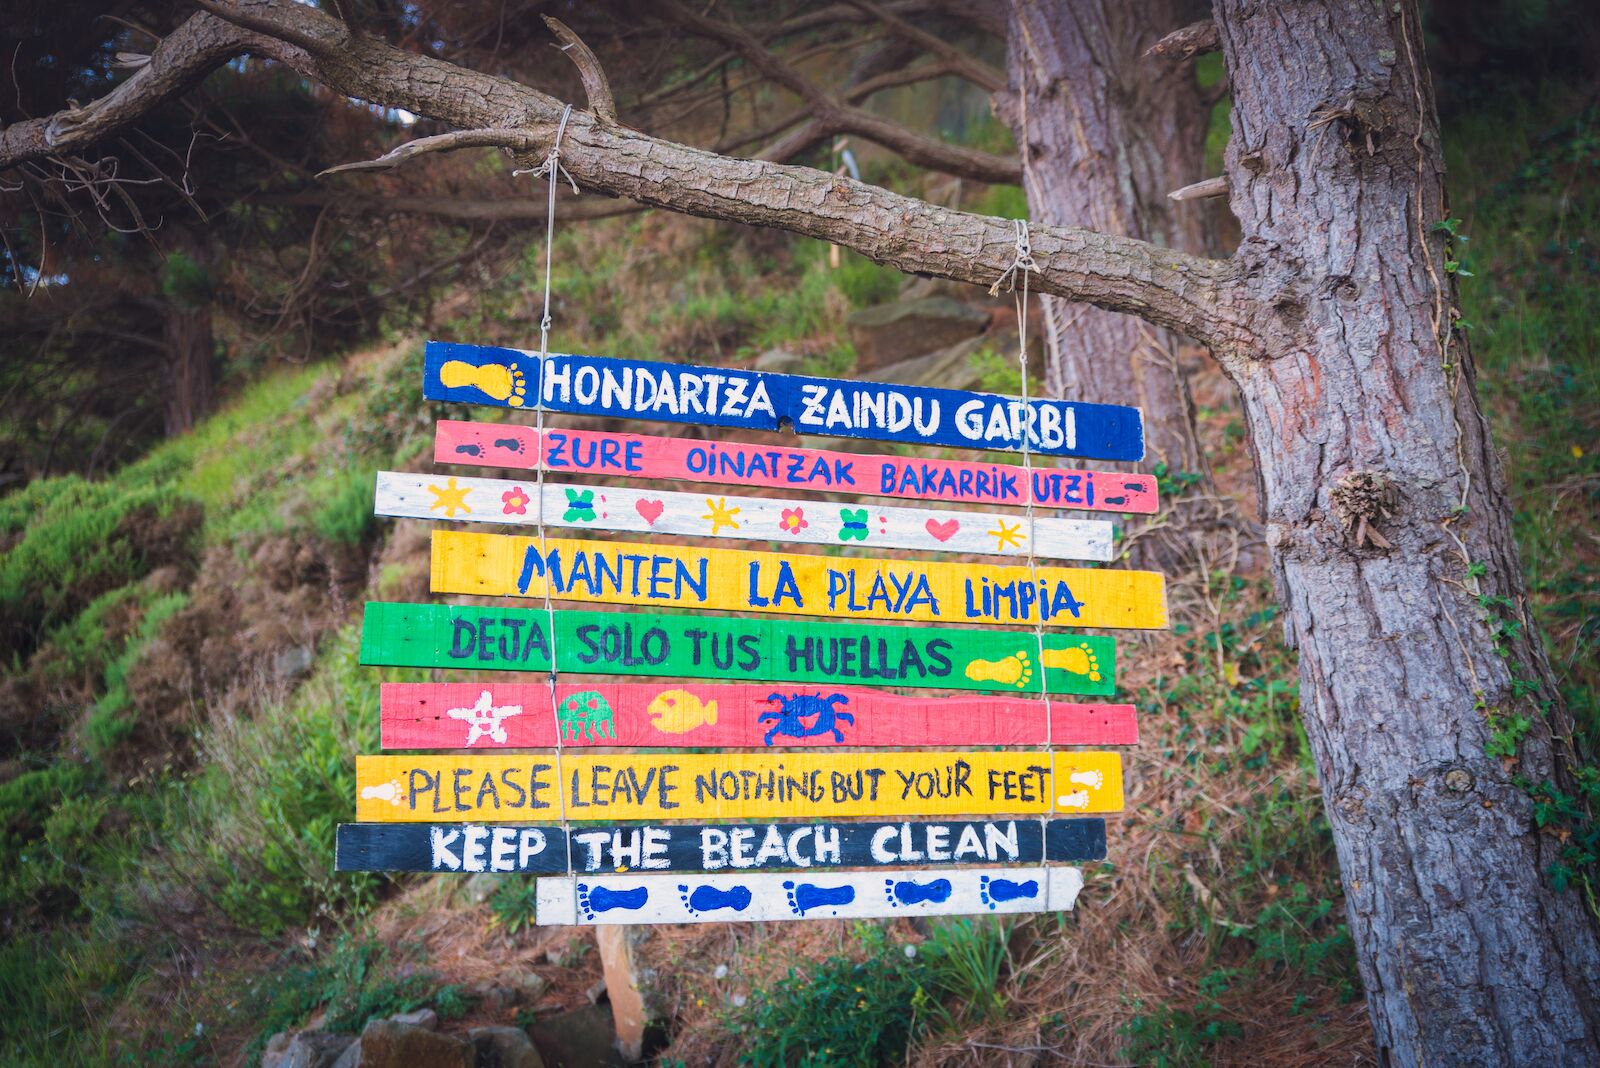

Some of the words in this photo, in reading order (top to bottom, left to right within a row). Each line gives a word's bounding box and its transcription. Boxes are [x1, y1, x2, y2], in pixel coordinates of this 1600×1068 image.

[542, 359, 776, 419] HONDARTZA
[800, 385, 940, 437] ZAINDU
[955, 400, 1076, 450] GARBI
[547, 433, 643, 471] ZURE
[517, 545, 709, 602] MANTEN
[748, 560, 803, 607] LA
[827, 568, 940, 616] PLAYA
[449, 616, 550, 662] DEJA
[576, 622, 671, 667] SOLO
[684, 629, 760, 672] TUS
[785, 635, 953, 679] HUELLAS
[409, 763, 552, 813] PLEASE
[571, 765, 680, 809] LEAVE
[831, 765, 886, 803] BUT
[895, 758, 974, 801] YOUR
[987, 764, 1052, 804] FEET
[430, 825, 547, 872] KEEP
[573, 825, 671, 872] THE
[700, 824, 841, 870] BEACH
[870, 820, 1020, 864] CLEAN
